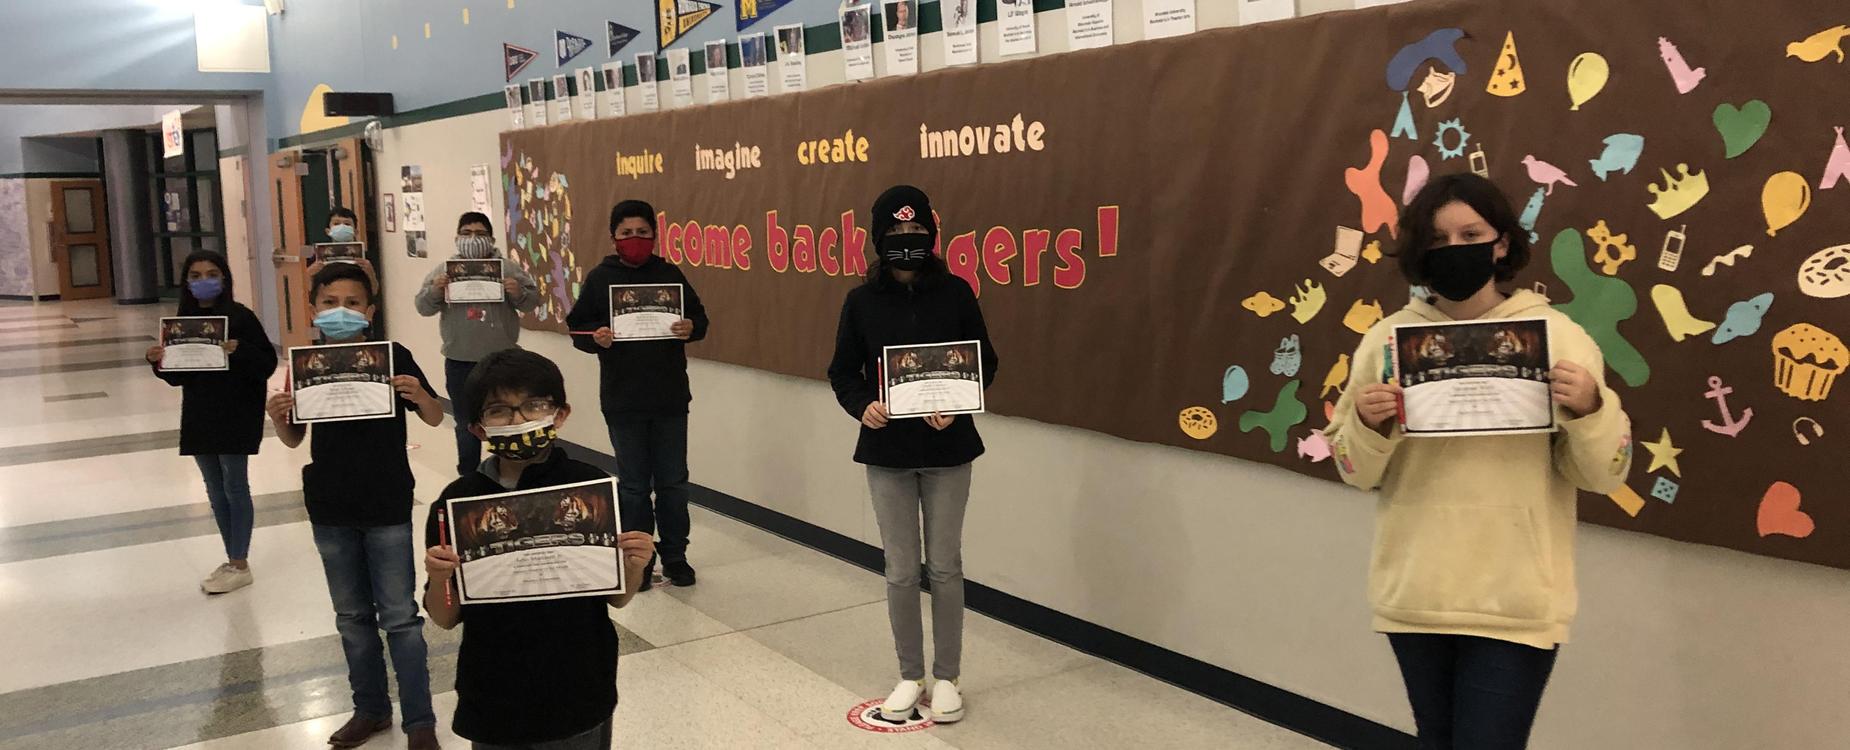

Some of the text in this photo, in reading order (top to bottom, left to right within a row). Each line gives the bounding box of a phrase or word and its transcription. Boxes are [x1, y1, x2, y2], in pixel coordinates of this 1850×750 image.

[616, 112, 1046, 180] inquire imagine create innovate
[657, 211, 752, 271] lcome
[766, 209, 869, 277] back
